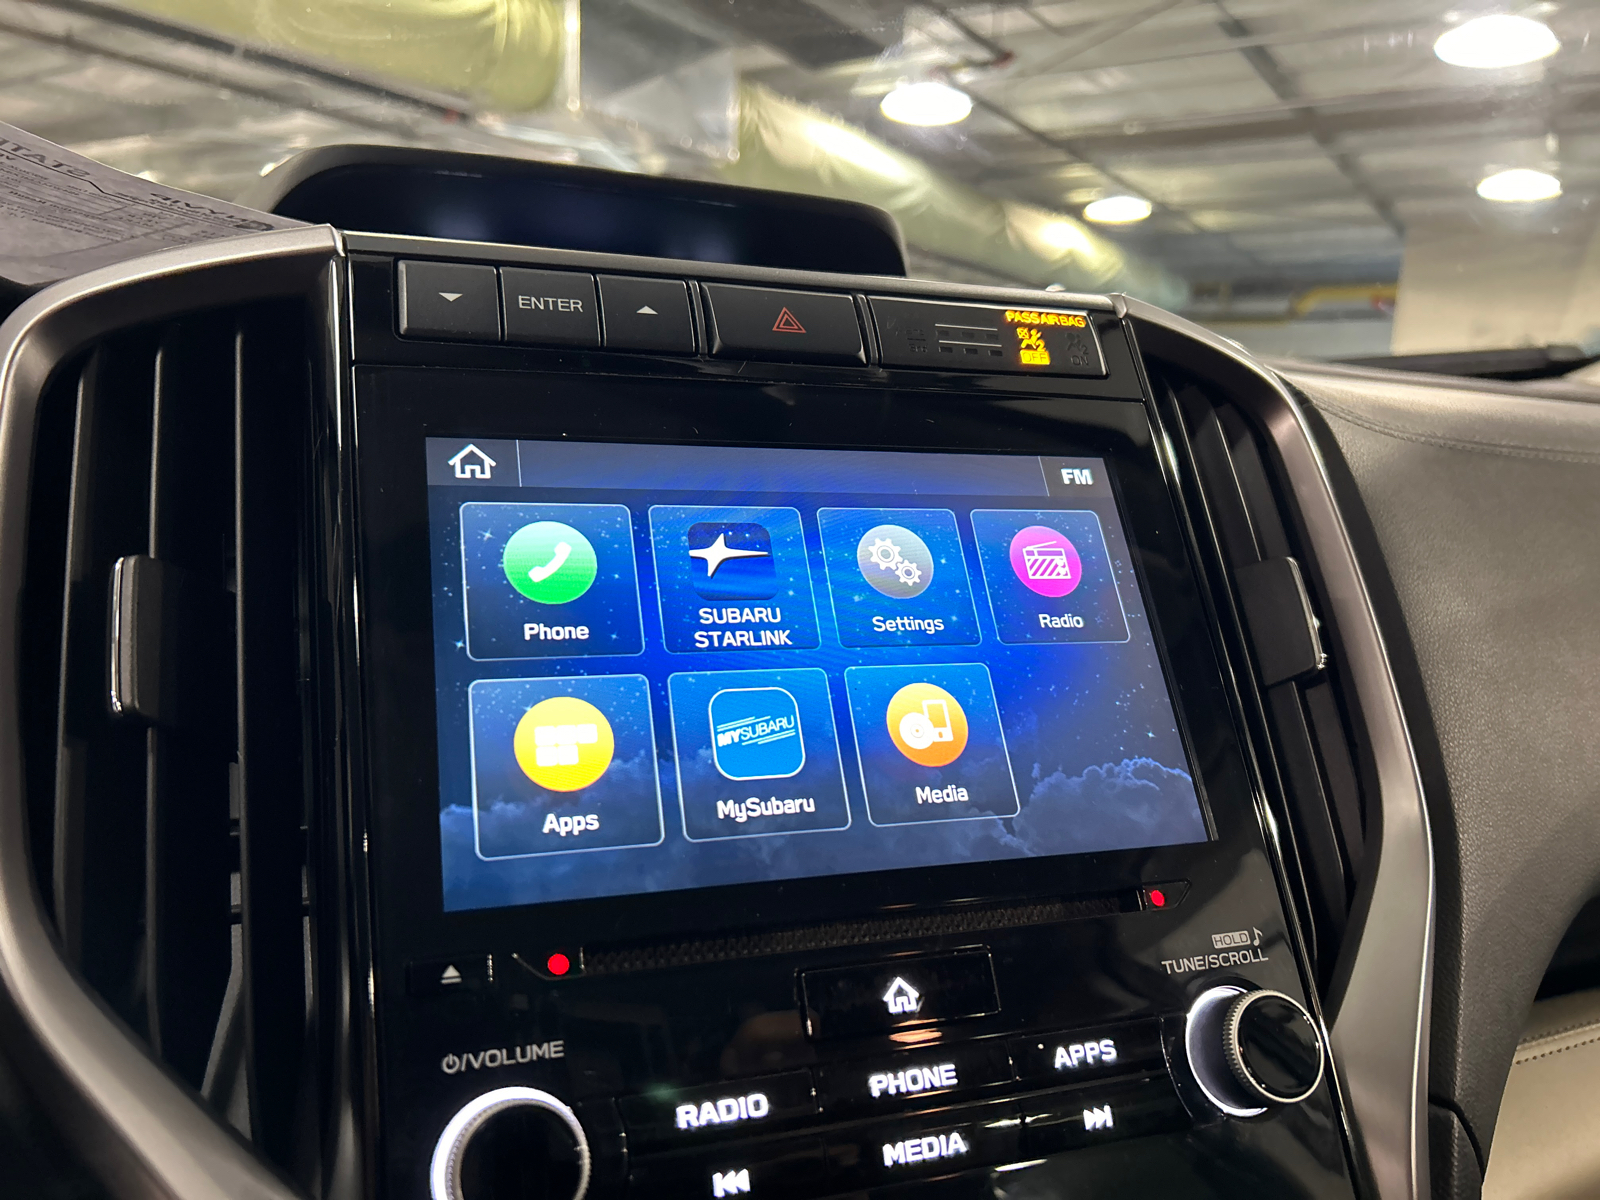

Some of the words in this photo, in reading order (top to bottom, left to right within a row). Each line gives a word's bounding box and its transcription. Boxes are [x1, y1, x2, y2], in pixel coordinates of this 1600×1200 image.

[517, 295, 584, 313] ENTER
[1022, 351, 1048, 363] OFF
[1060, 467, 1094, 486] FM
[698, 606, 782, 625] SUBARU
[871, 615, 945, 635] Settings
[1038, 613, 1085, 629] Radio
[523, 622, 590, 641] Phone
[693, 629, 793, 649] STARLINK
[915, 783, 969, 806] Media
[716, 796, 816, 823] MySubaru
[541, 811, 600, 837] Apps
[1212, 932, 1249, 947] HOLD
[1160, 948, 1269, 975] TUNE/SCROLL
[1054, 1038, 1118, 1070] APPS
[867, 1063, 958, 1098] PHONE
[675, 1092, 769, 1130] RADIO
[882, 1130, 969, 1168] MEDIA
